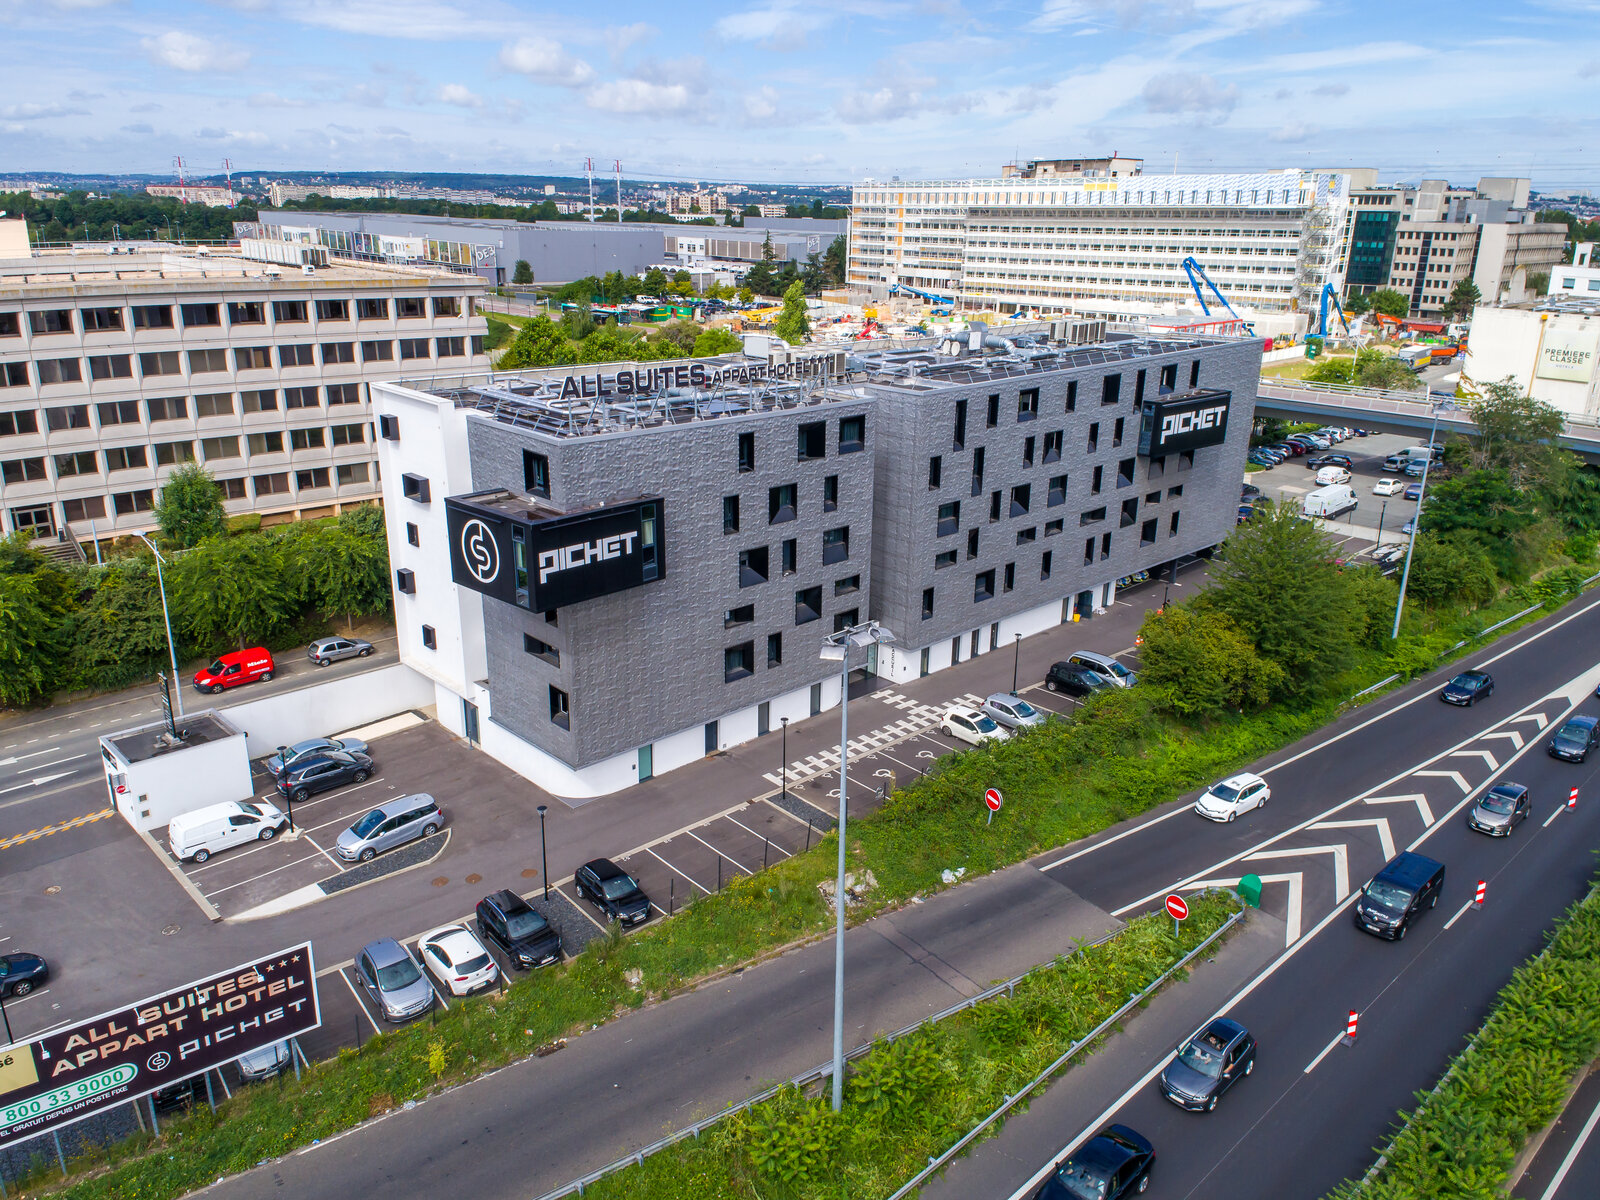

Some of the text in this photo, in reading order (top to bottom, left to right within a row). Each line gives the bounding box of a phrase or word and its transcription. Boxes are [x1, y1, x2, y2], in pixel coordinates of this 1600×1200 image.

[476, 246, 494, 261] DE3
[1544, 348, 1592, 359] PREMIERE
[1549, 355, 1584, 364] CLASSE
[559, 361, 810, 400] ALL SUITES APPART HOTEL
[1160, 405, 1227, 445] PICHET
[538, 530, 638, 585] PICHET
[246, 658, 269, 668] Miele
[51, 975, 305, 1078] APPART HOTEL
[64, 970, 260, 1053] ALL SUITES
[178, 997, 307, 1060] PICHET
[5, 1070, 124, 1122] 800 33 9000
[12, 1116, 45, 1132] GRATUIT
[45, 1106, 74, 1121] DEPUIS
[73, 1101, 86, 1110] UN
[86, 1091, 111, 1106] POSTE
[111, 1085, 129, 1096] FIXE
